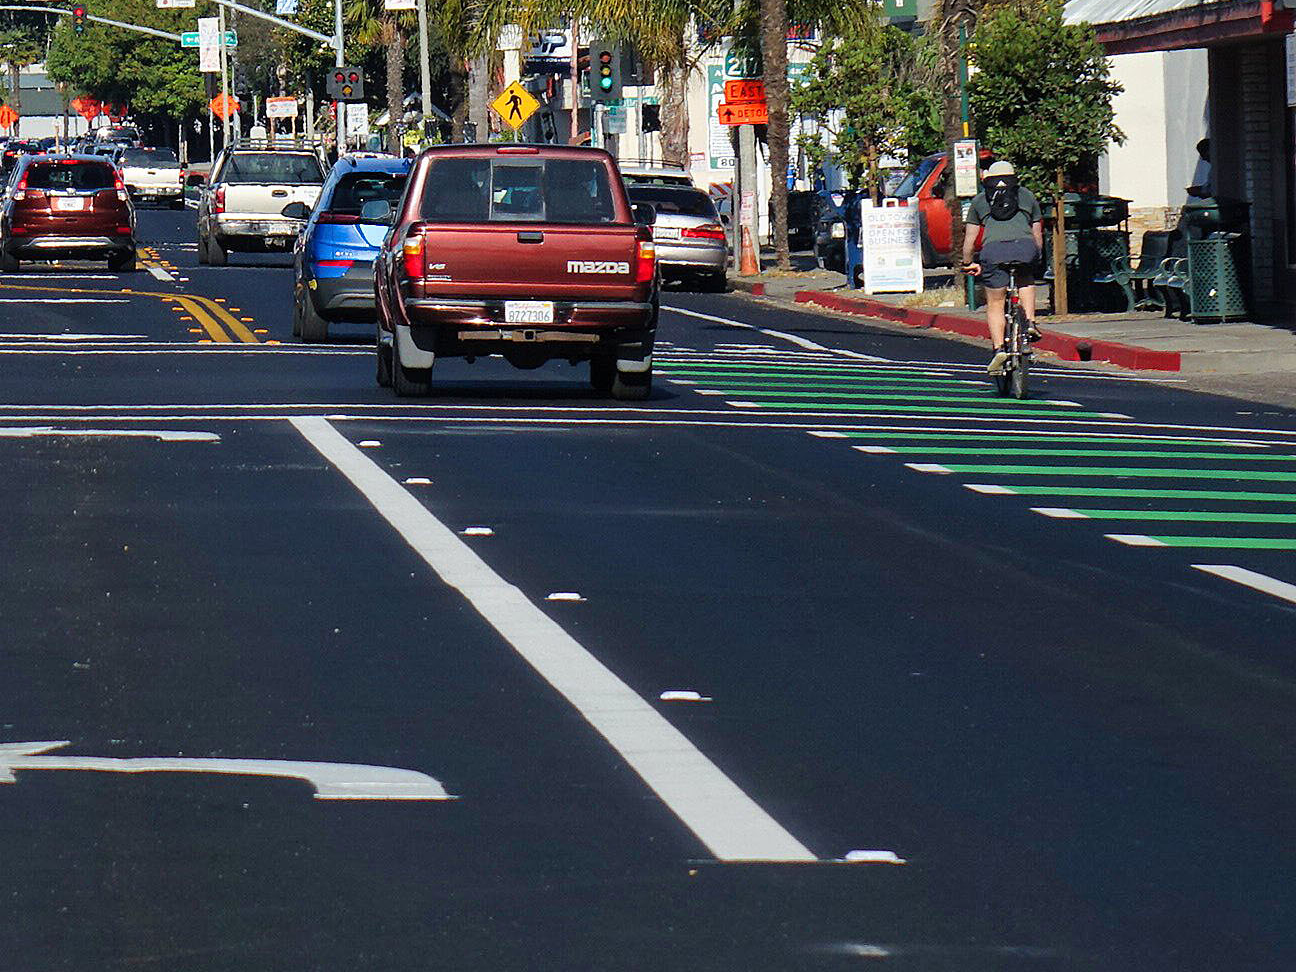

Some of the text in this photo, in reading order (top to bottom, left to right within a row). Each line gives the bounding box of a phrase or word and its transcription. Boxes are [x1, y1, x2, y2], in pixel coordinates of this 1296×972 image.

[730, 84, 765, 98] EAST
[737, 109, 769, 119] DETOU
[868, 213, 917, 222] OLD TOWN
[868, 228, 916, 237] OPEN FOR
[868, 236, 917, 245] BUSINESS
